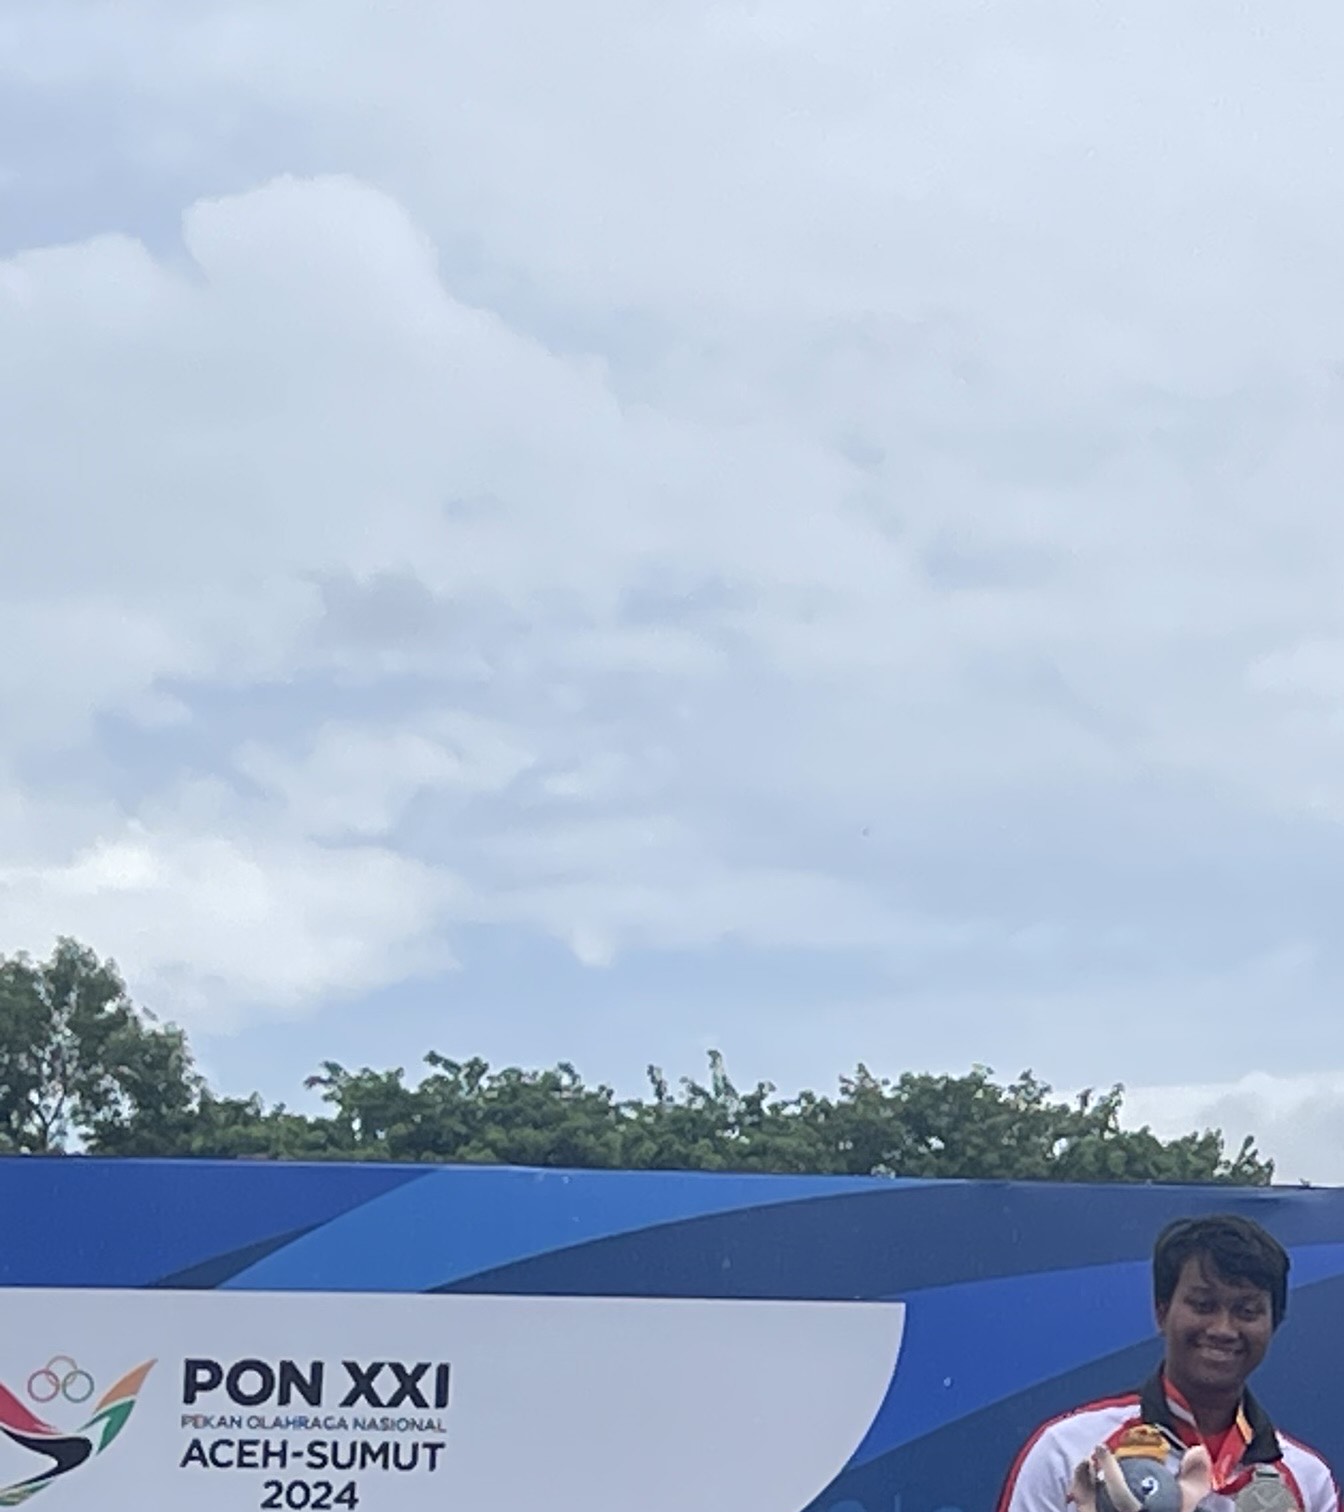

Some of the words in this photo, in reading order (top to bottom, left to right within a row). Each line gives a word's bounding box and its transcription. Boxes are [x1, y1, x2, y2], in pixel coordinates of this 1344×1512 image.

[182, 1358, 324, 1407] PON
[340, 1360, 451, 1409] XXI
[181, 1414, 242, 1429] PEKAN
[353, 1417, 447, 1433] NASIONAL
[179, 1439, 445, 1471] ACEH-SUMUT
[260, 1480, 359, 1510] 2024
